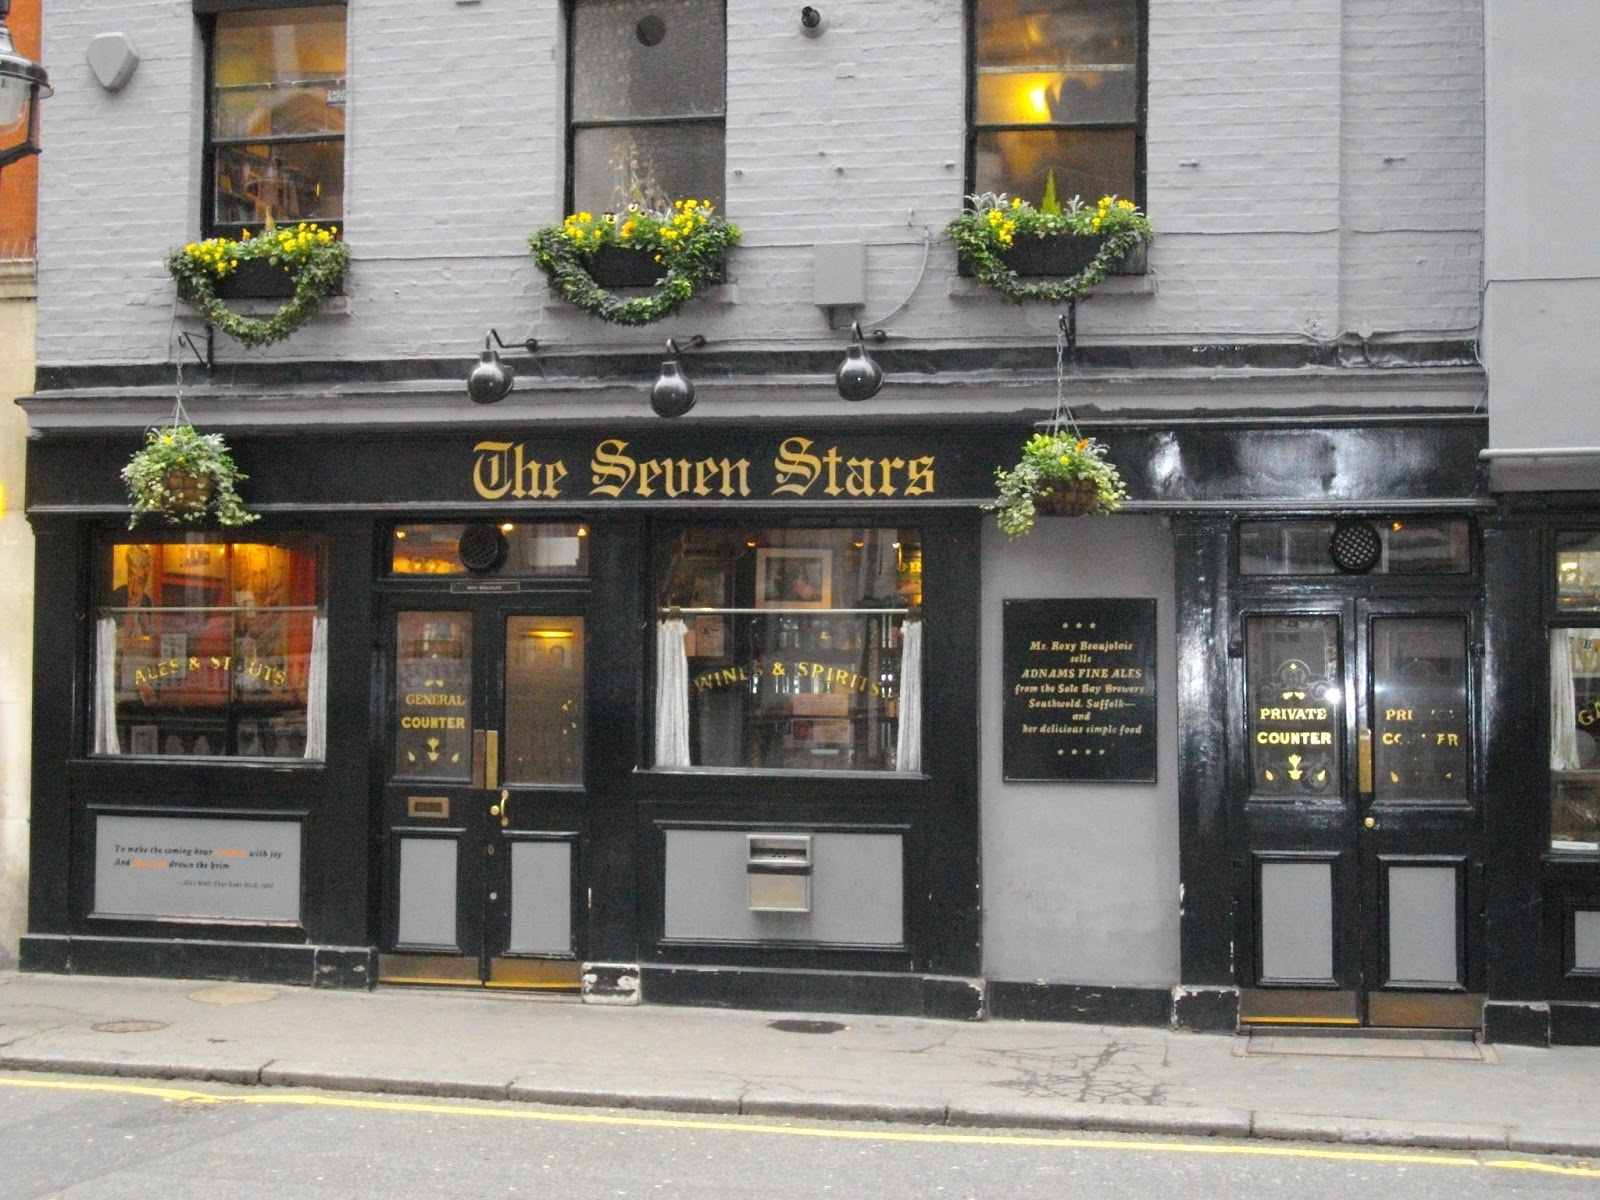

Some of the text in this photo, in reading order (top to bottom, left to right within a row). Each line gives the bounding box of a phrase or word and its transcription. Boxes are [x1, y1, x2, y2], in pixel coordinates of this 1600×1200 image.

[473, 437, 935, 499] The Seven Stars
[1051, 641, 1077, 652] Roxy
[1080, 641, 1133, 653] Beaujolais
[1070, 654, 1092, 663] sells
[135, 656, 286, 685] ALES & STUTS
[1021, 668, 1142, 679] ADNAMS FINE ALES
[772, 662, 786, 676] &
[797, 662, 881, 696] SPIRITS
[1014, 683, 1146, 695] from the Sole Bay Brewery
[405, 693, 466, 706] GENERAL
[1072, 712, 1091, 721] and
[1260, 708, 1328, 720] PRIVATE
[401, 716, 466, 729] COUNTER
[1022, 724, 1143, 736] her delicious simple food
[1256, 732, 1332, 745] COUNTER
[114, 844, 126, 852] To
[128, 846, 148, 854] make
[150, 846, 162, 854] the
[164, 848, 192, 857] coming
[194, 847, 213, 856] hour
[249, 849, 268, 858] with
[269, 850, 282, 860] joy
[114, 858, 131, 867] And
[168, 860, 194, 869] drown
[195, 861, 208, 869] the
[210, 861, 230, 870] brim
